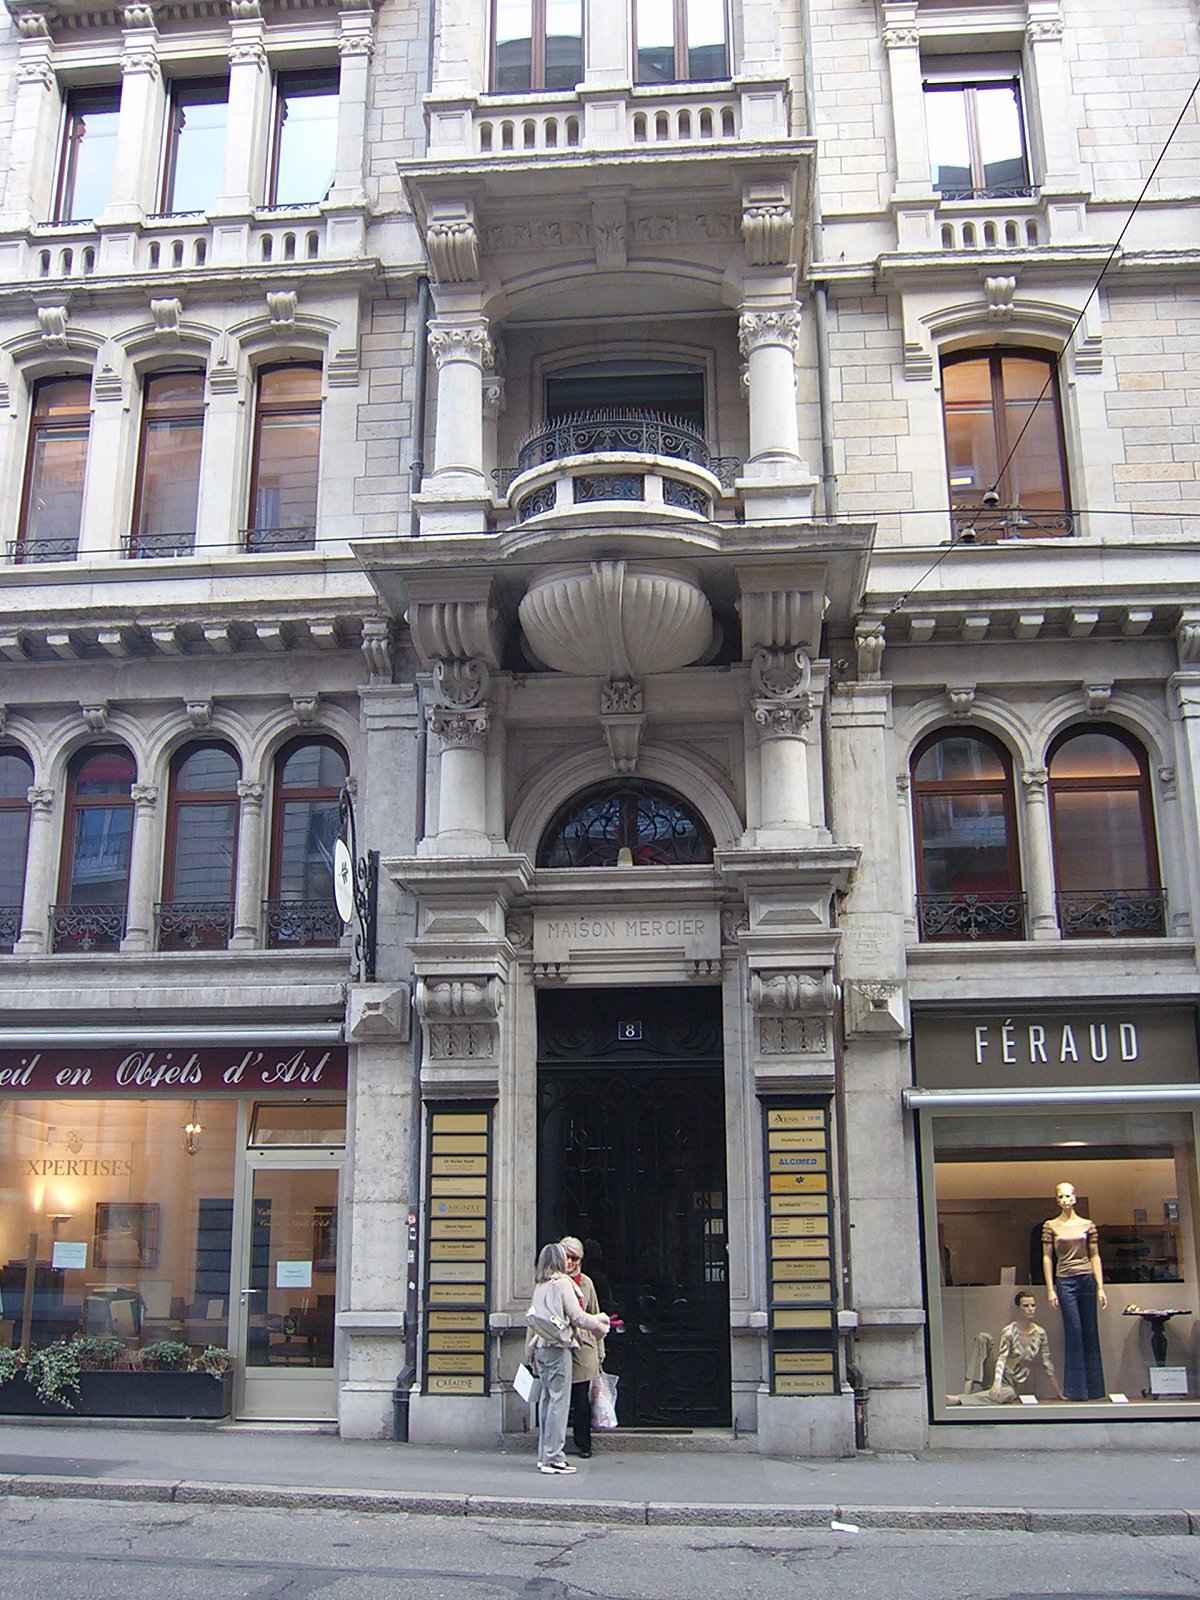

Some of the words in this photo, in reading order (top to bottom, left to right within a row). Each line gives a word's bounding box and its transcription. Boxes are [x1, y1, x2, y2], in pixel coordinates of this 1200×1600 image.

[547, 921, 616, 939] MAISON
[625, 919, 705, 937] MERCIER
[625, 1023, 636, 1038] 8
[974, 1018, 1140, 1065] FÉRAUD
[55, 1066, 93, 1086] en
[116, 1050, 202, 1088] Objets
[16, 1158, 135, 1177] EXPERTISES
[778, 1158, 818, 1166] ALCIMED
